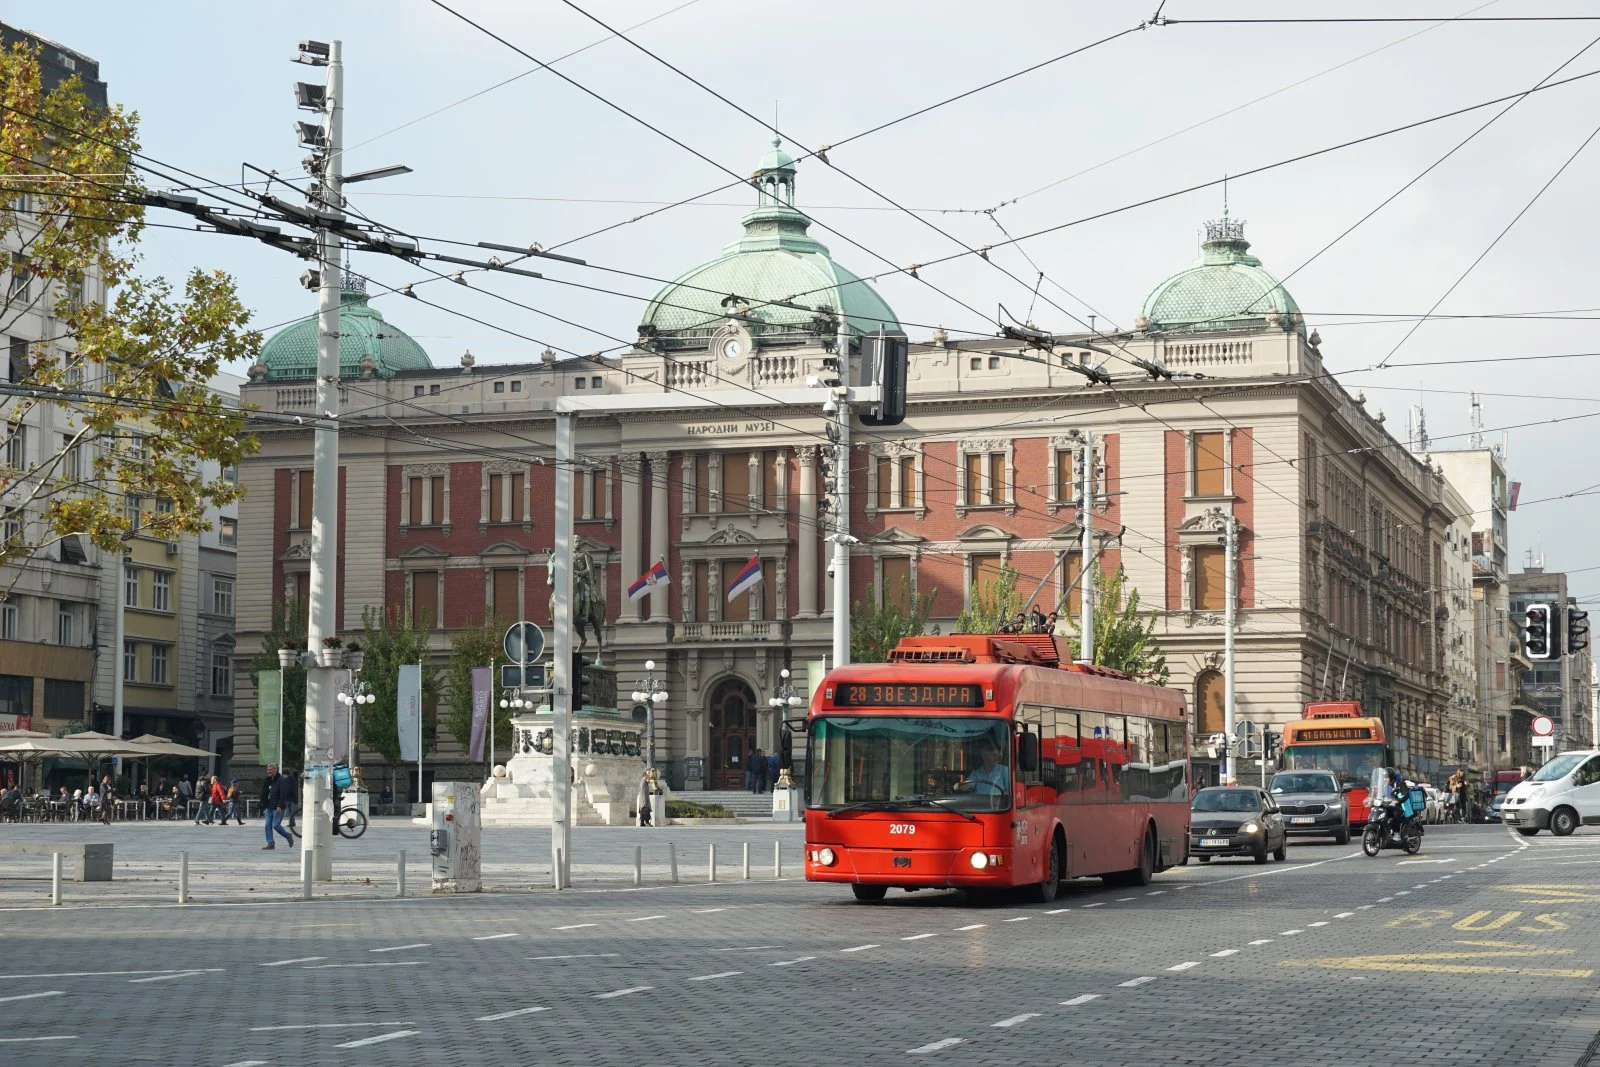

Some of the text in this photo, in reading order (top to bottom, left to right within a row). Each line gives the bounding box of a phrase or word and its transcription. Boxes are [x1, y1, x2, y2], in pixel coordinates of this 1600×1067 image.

[687, 424, 737, 435] НАРОДНИ
[850, 687, 969, 703] 28 ЗВЕЗДАРА
[889, 823, 916, 835] 2079
[1385, 909, 1576, 932] BUS
